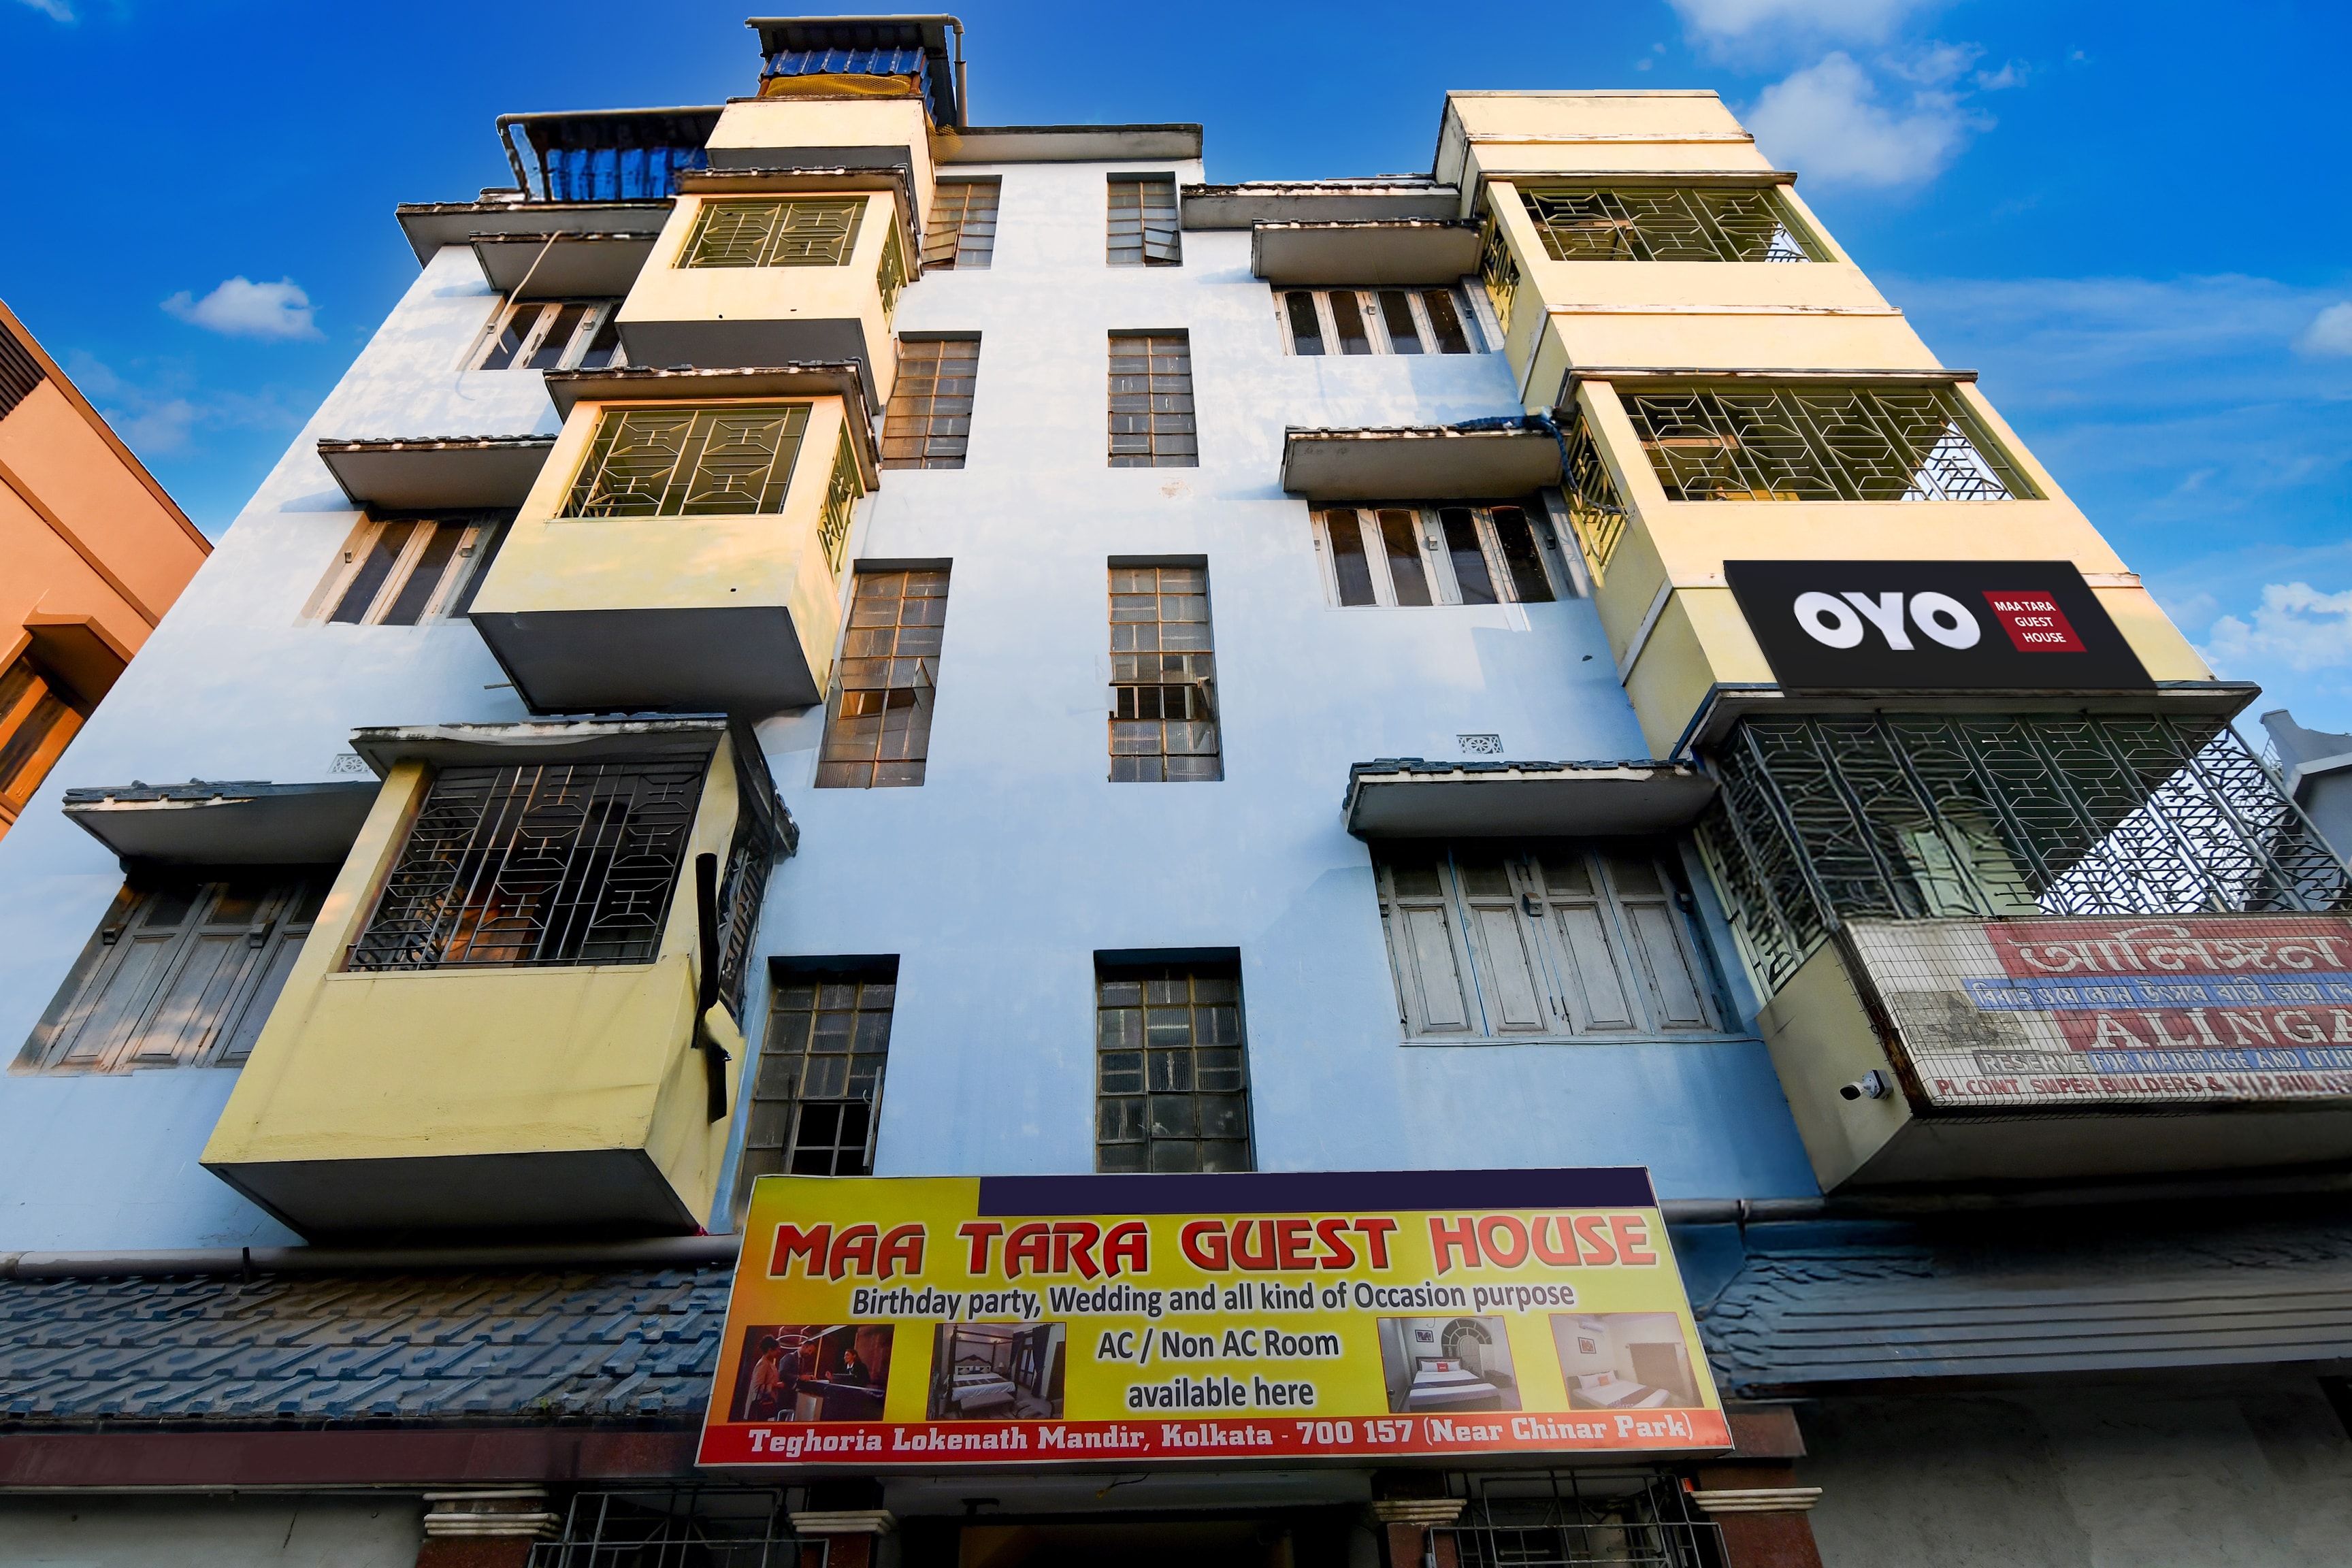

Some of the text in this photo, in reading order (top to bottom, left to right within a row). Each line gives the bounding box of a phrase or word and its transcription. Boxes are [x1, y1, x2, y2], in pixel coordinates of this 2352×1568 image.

[1794, 591, 1981, 650] OYO
[1993, 601, 2056, 611] MAA TARA
[2014, 617, 2054, 627] GUEST
[2022, 632, 2067, 642] HOUSE
[1980, 1052, 2090, 1073] RESERVE
[2095, 1053, 2134, 1071] FOR
[2257, 1049, 2301, 1068] AND
[2306, 1049, 2352, 1067] OTH
[2030, 1077, 2097, 1094] SUPER
[2099, 1076, 2203, 1093] BUILDERS
[2206, 1075, 2225, 1091] &
[770, 1215, 1656, 1281] MAA TARA GUEST HOUSE
[853, 1281, 1575, 1320] Birthday party, Wedding and all kind of Occasion purpose
[1097, 1328, 1339, 1364] AC / Non AC Room
[1129, 1376, 1314, 1407] available here
[749, 1428, 882, 1458] Teghoria
[892, 1426, 1027, 1450] Lokenath
[1038, 1424, 1150, 1452] Mandir,
[1162, 1423, 1273, 1447] Kolkata
[1296, 1421, 1354, 1444] 700
[1362, 1420, 1413, 1442] 157
[1422, 1416, 1503, 1446] (Near
[1511, 1417, 1607, 1439] Chinar
[1614, 1411, 1694, 1440] Park)
